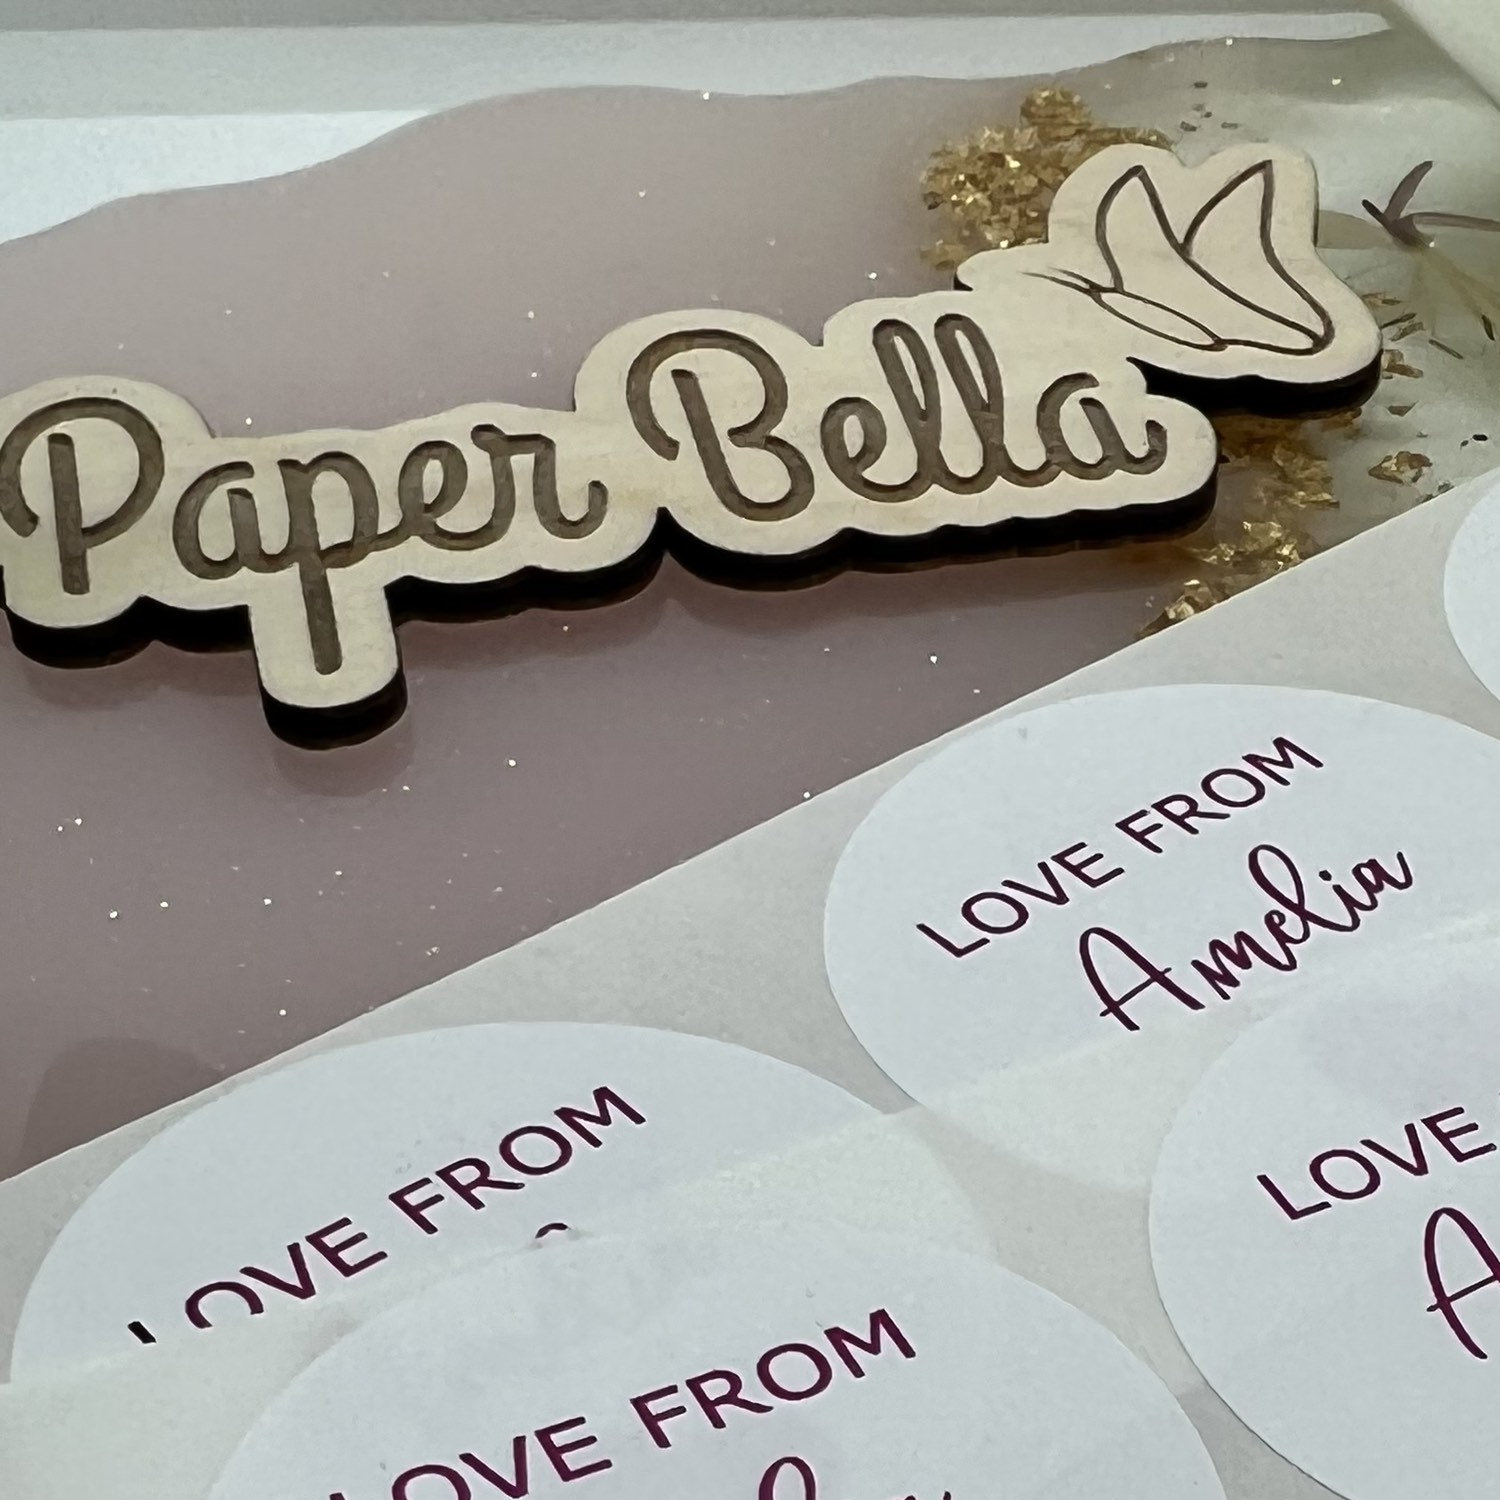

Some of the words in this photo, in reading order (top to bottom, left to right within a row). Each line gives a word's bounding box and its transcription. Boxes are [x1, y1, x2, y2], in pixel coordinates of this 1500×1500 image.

[0, 396, 607, 675] Paper
[627, 312, 1170, 522] Bella
[918, 842, 1125, 958] LOVE
[1115, 737, 1323, 853] FROM
[1079, 844, 1413, 1030] Amelia
[388, 1086, 646, 1234] FROM
[1257, 1107, 1497, 1220] LOVE
[630, 1309, 916, 1448] FROM
